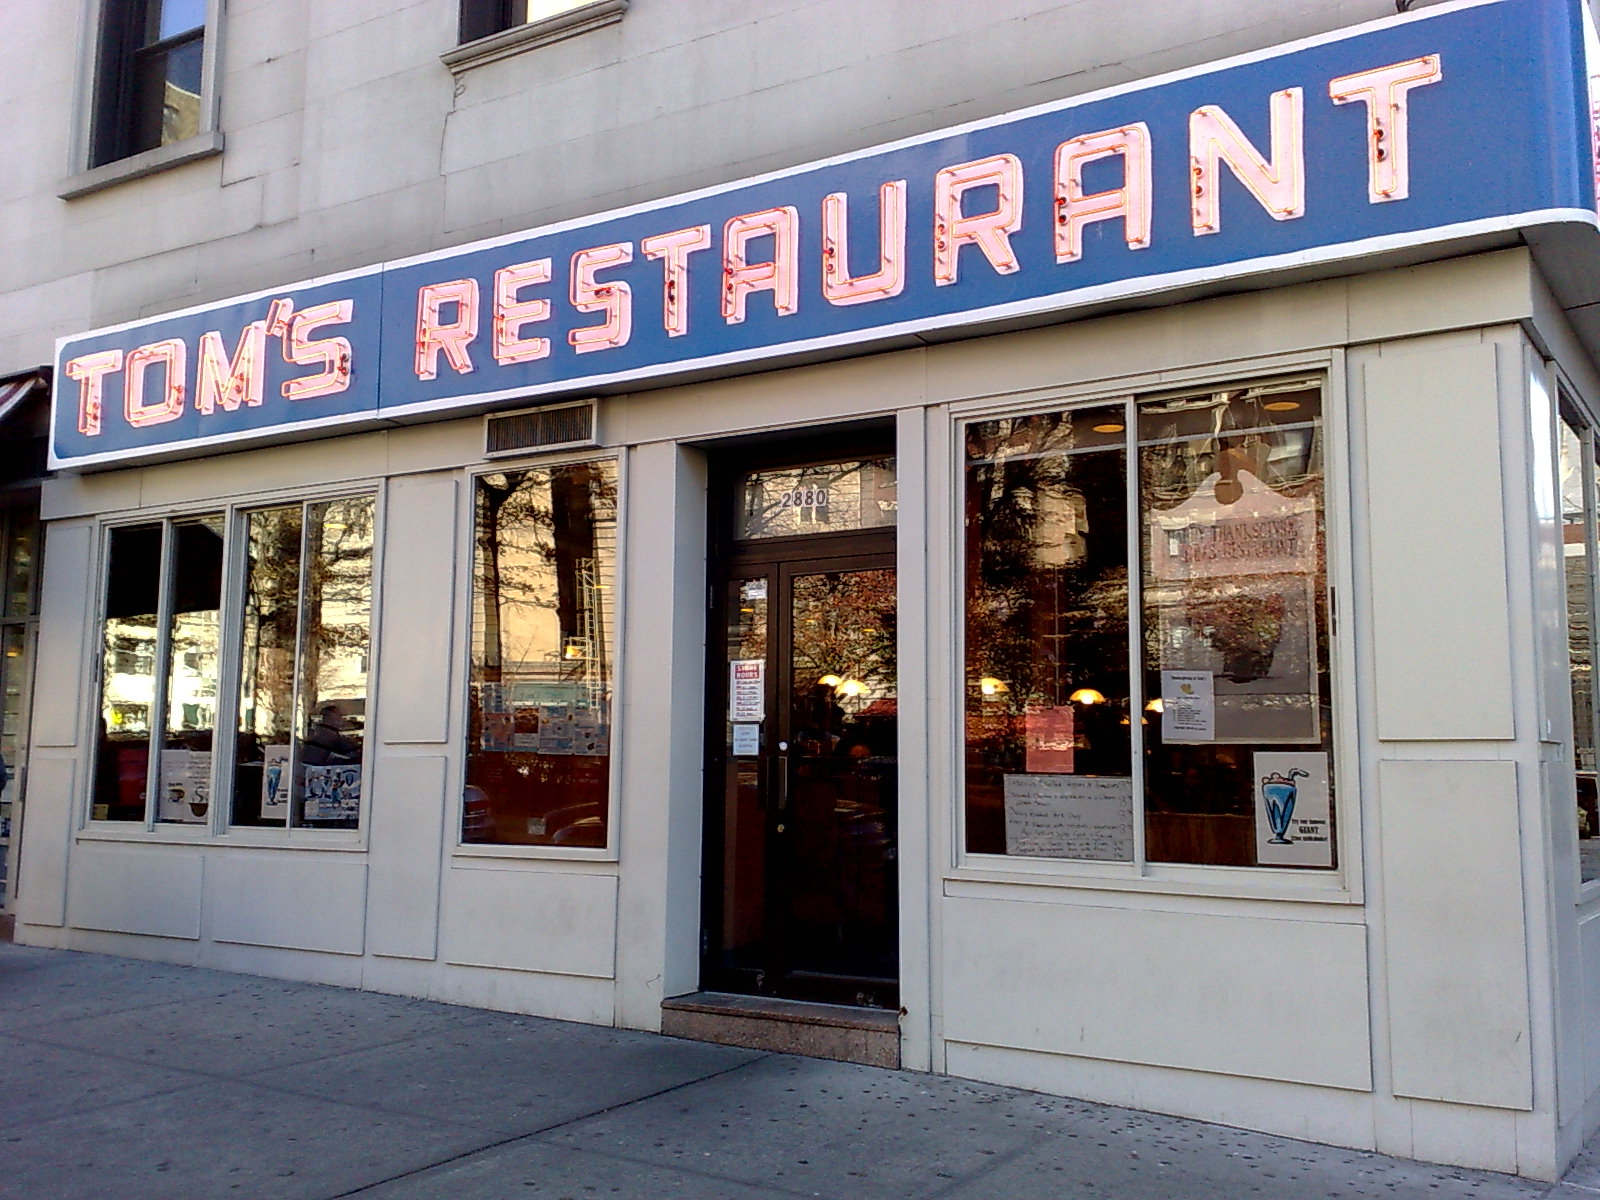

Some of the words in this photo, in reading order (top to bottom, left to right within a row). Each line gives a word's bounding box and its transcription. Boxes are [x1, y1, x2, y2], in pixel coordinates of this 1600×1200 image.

[65, 297, 353, 437] TOM'S
[414, 53, 1443, 381] RESTAURANT
[782, 490, 826, 508] 2880
[1299, 826, 1318, 834] GIANT
